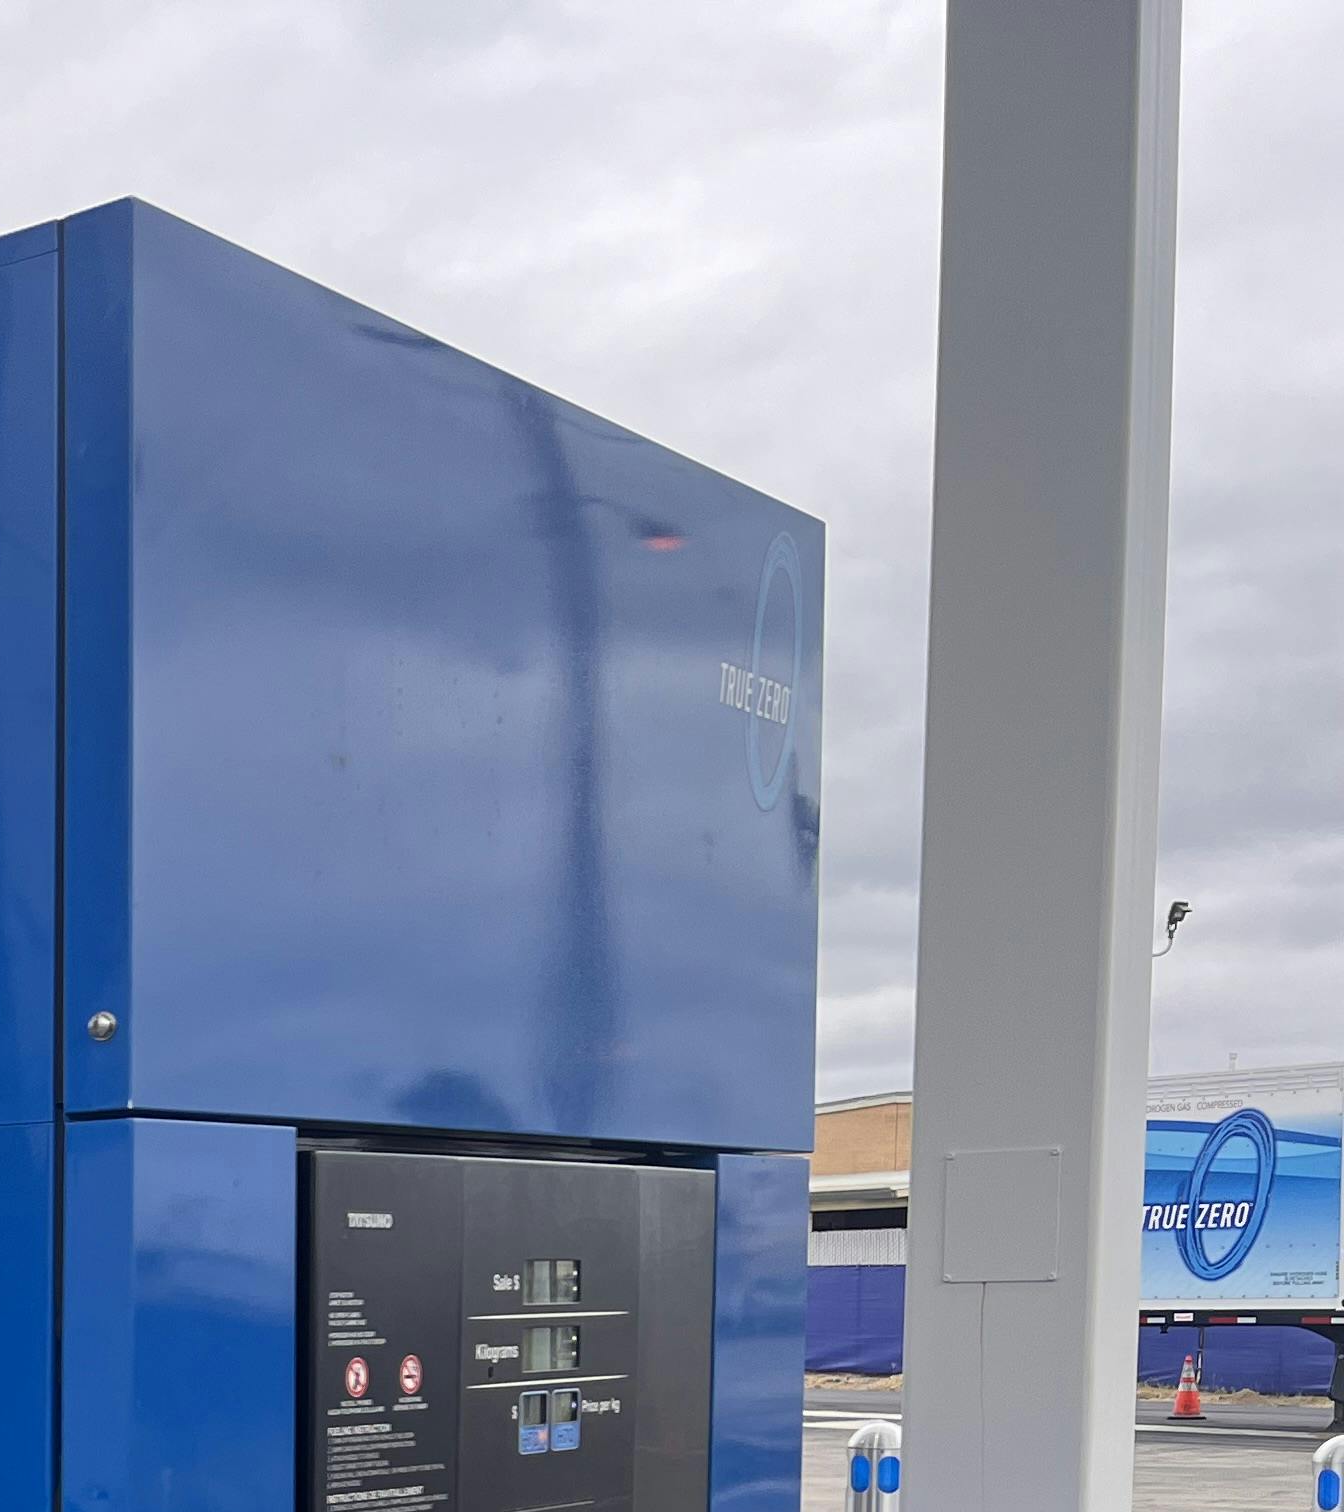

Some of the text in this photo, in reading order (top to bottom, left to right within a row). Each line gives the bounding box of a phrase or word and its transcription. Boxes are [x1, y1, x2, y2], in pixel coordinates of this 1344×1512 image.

[720, 662, 791, 725] TRUE ZERO
[1142, 1201, 1250, 1231] TRUE ZERO
